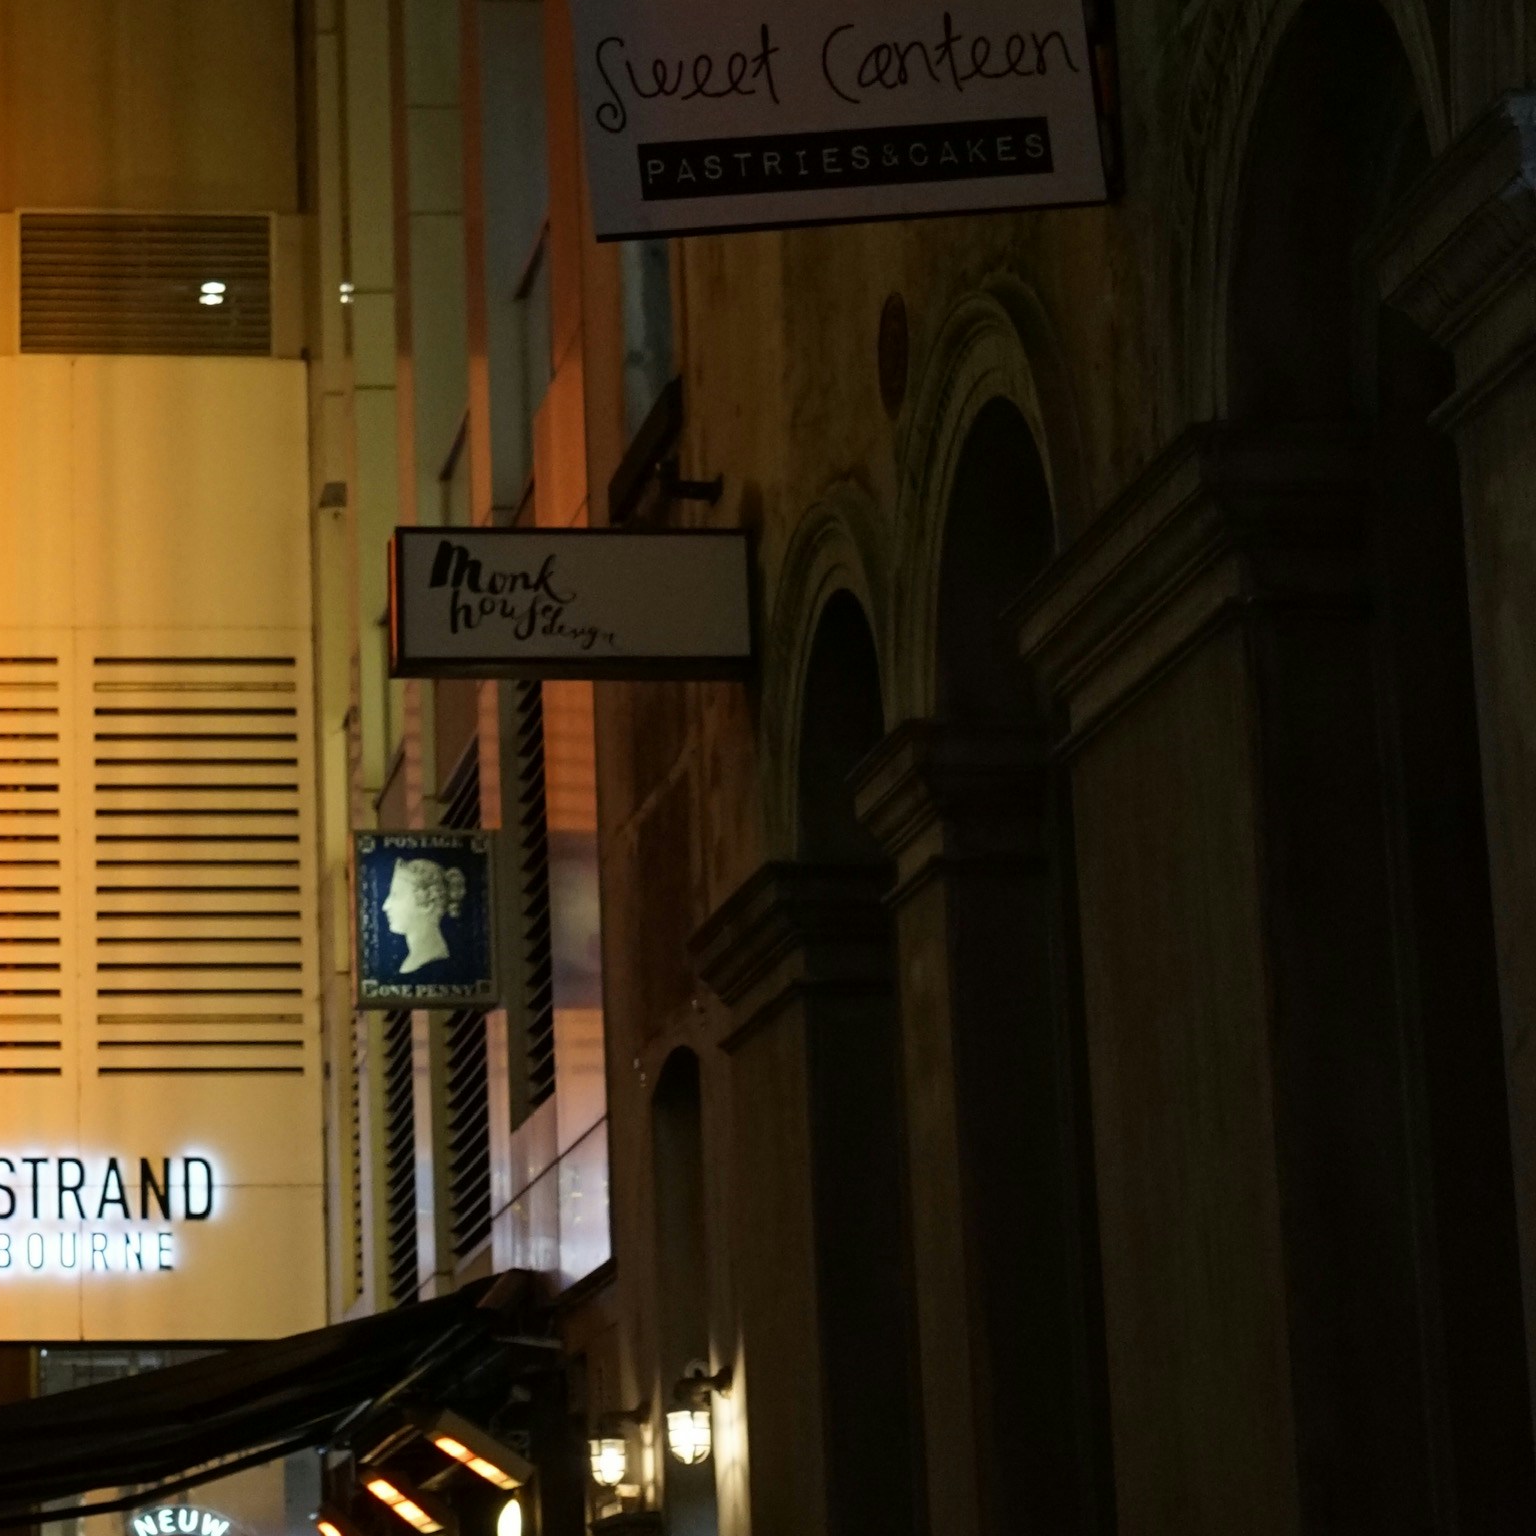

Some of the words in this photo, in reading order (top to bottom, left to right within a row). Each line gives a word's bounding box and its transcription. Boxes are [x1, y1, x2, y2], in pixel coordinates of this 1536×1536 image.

[595, 23, 780, 134] Sweet
[822, 11, 1079, 105] Canteen
[645, 132, 1048, 186] PASTRIES&CAKES
[429, 540, 577, 604] Monk
